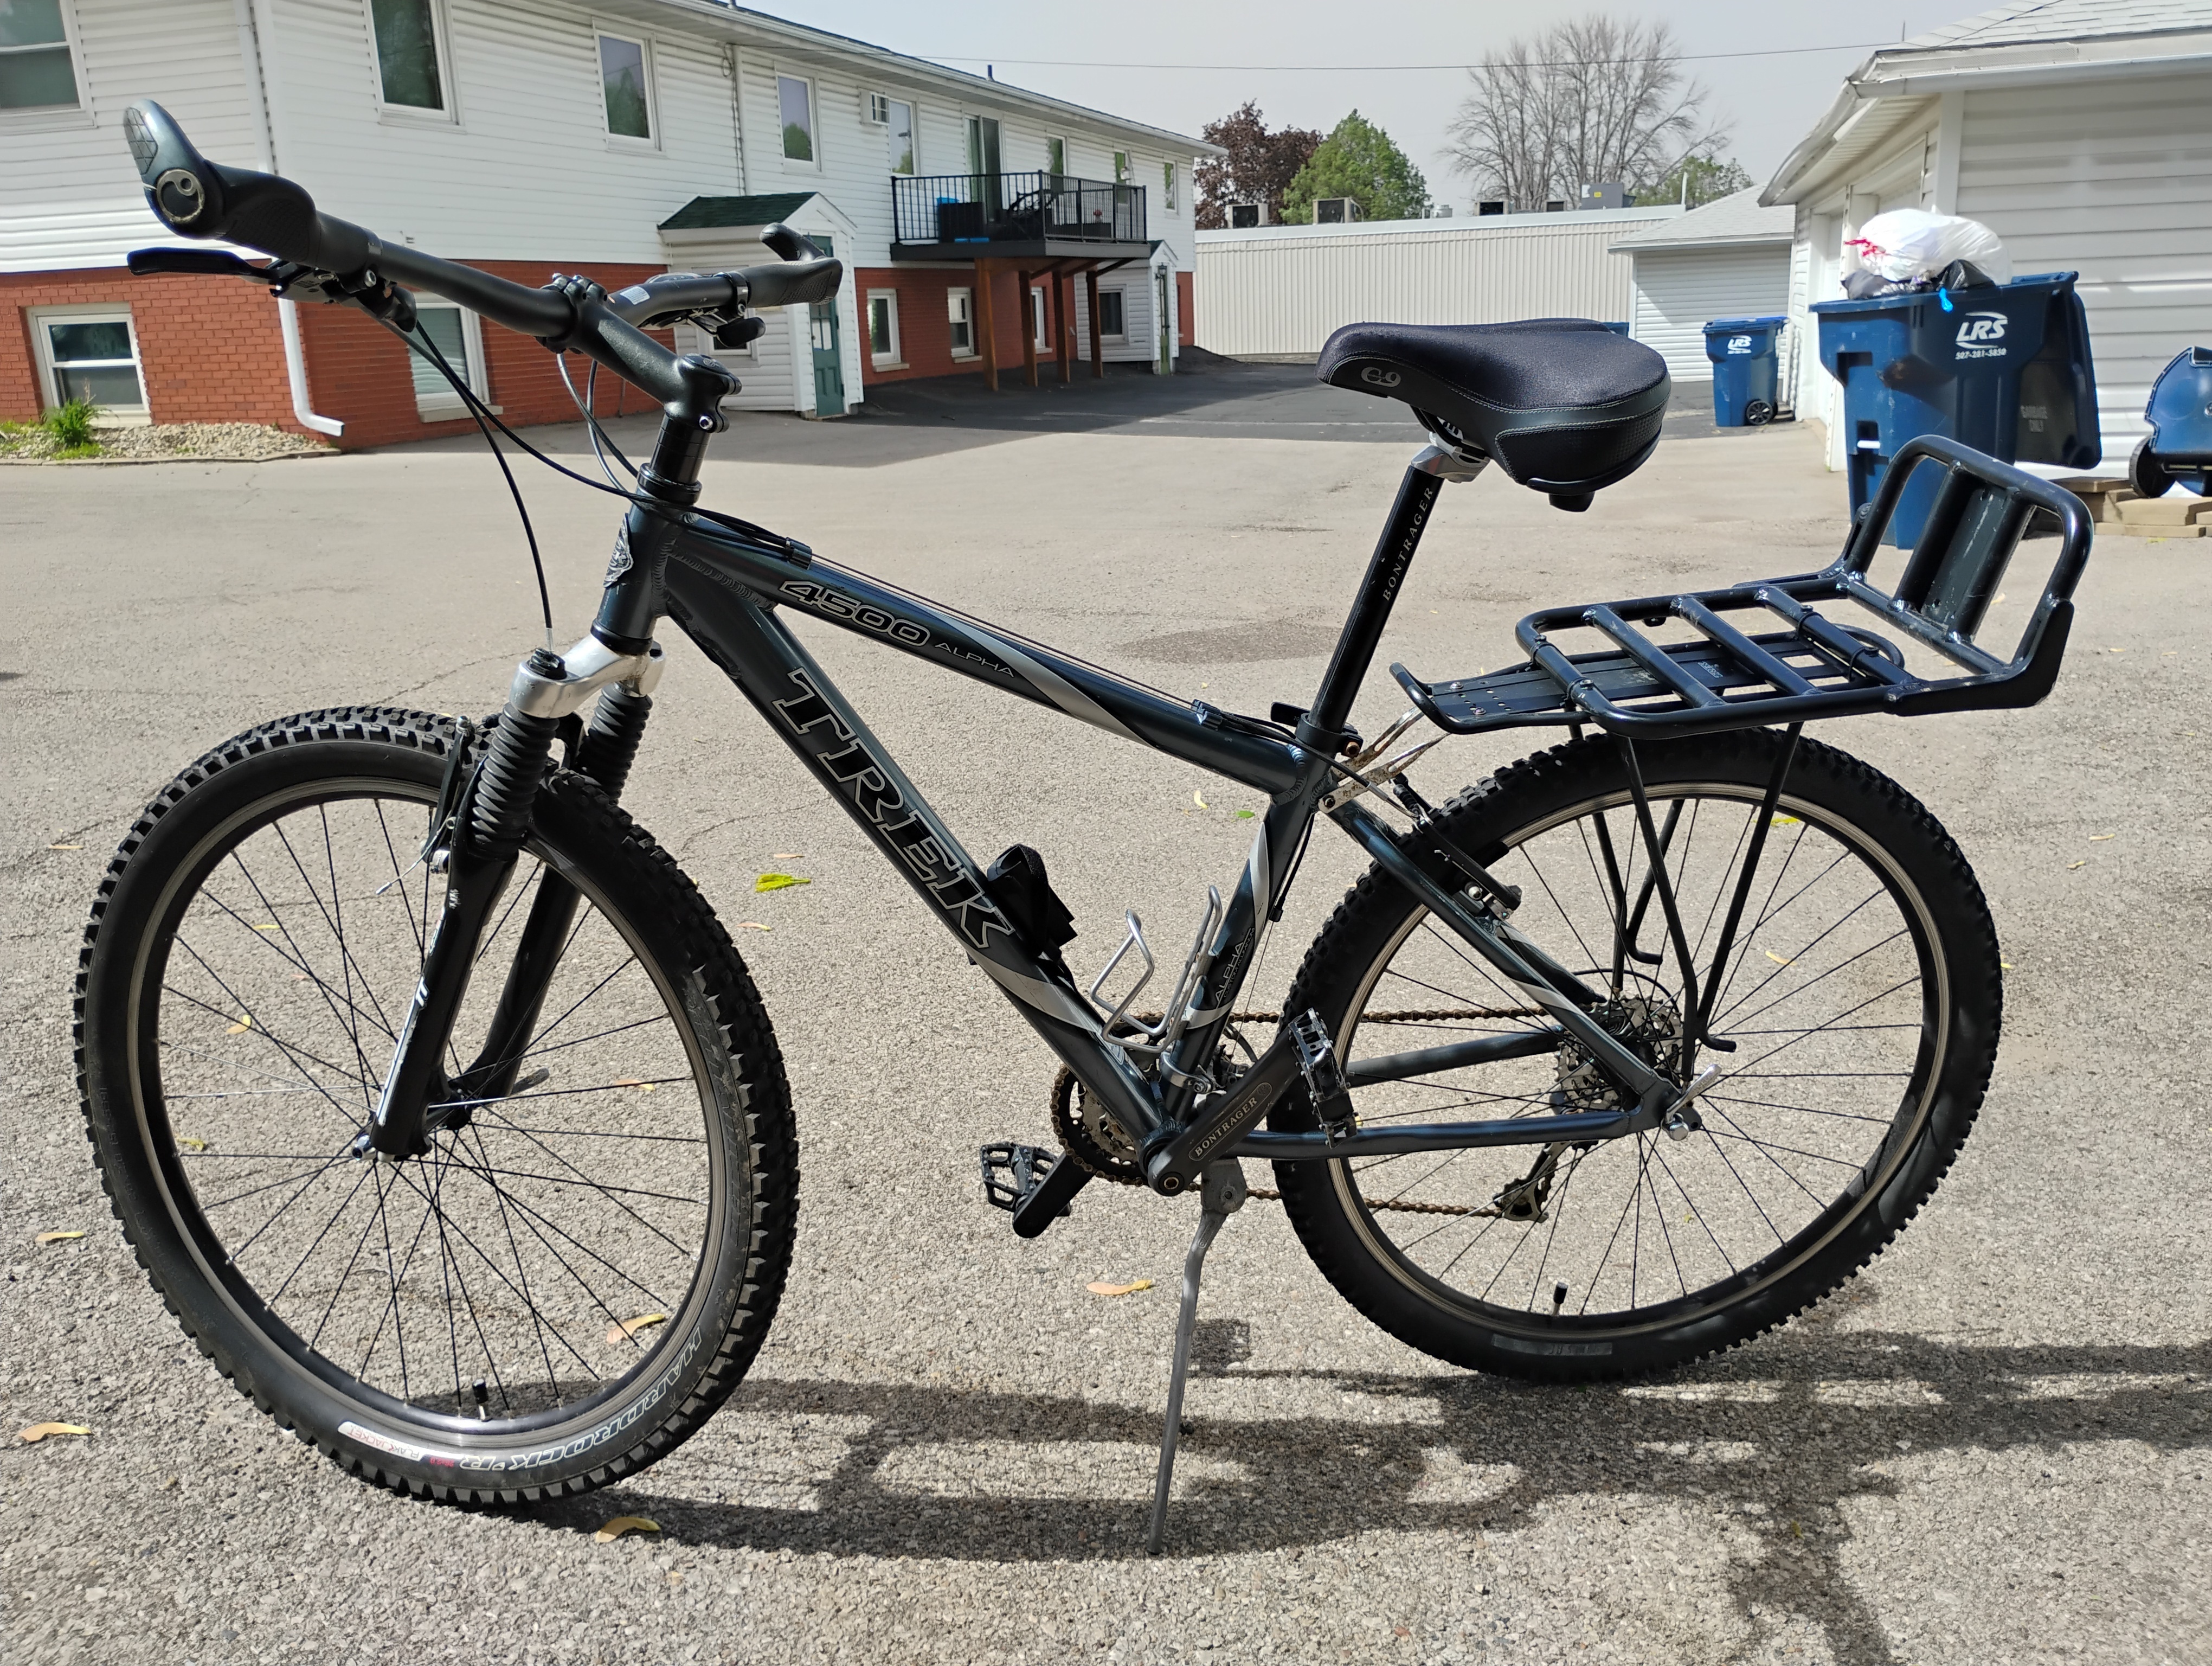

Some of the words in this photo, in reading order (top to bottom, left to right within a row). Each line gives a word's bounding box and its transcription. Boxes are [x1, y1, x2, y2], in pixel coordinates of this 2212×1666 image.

[1956, 319, 2008, 342] LRS
[1382, 488, 1433, 601] BONTRAGER
[779, 581, 931, 646] 4500
[935, 643, 1014, 677] ALPHA
[771, 667, 1015, 949] TREK
[1215, 941, 1244, 1002] ALPHA
[1224, 966, 1239, 998] CUSTOM
[1237, 928, 1255, 966] ALUMINUM
[1195, 1097, 1257, 1156] BONTRAGER
[347, 1428, 387, 1449] JACKET
